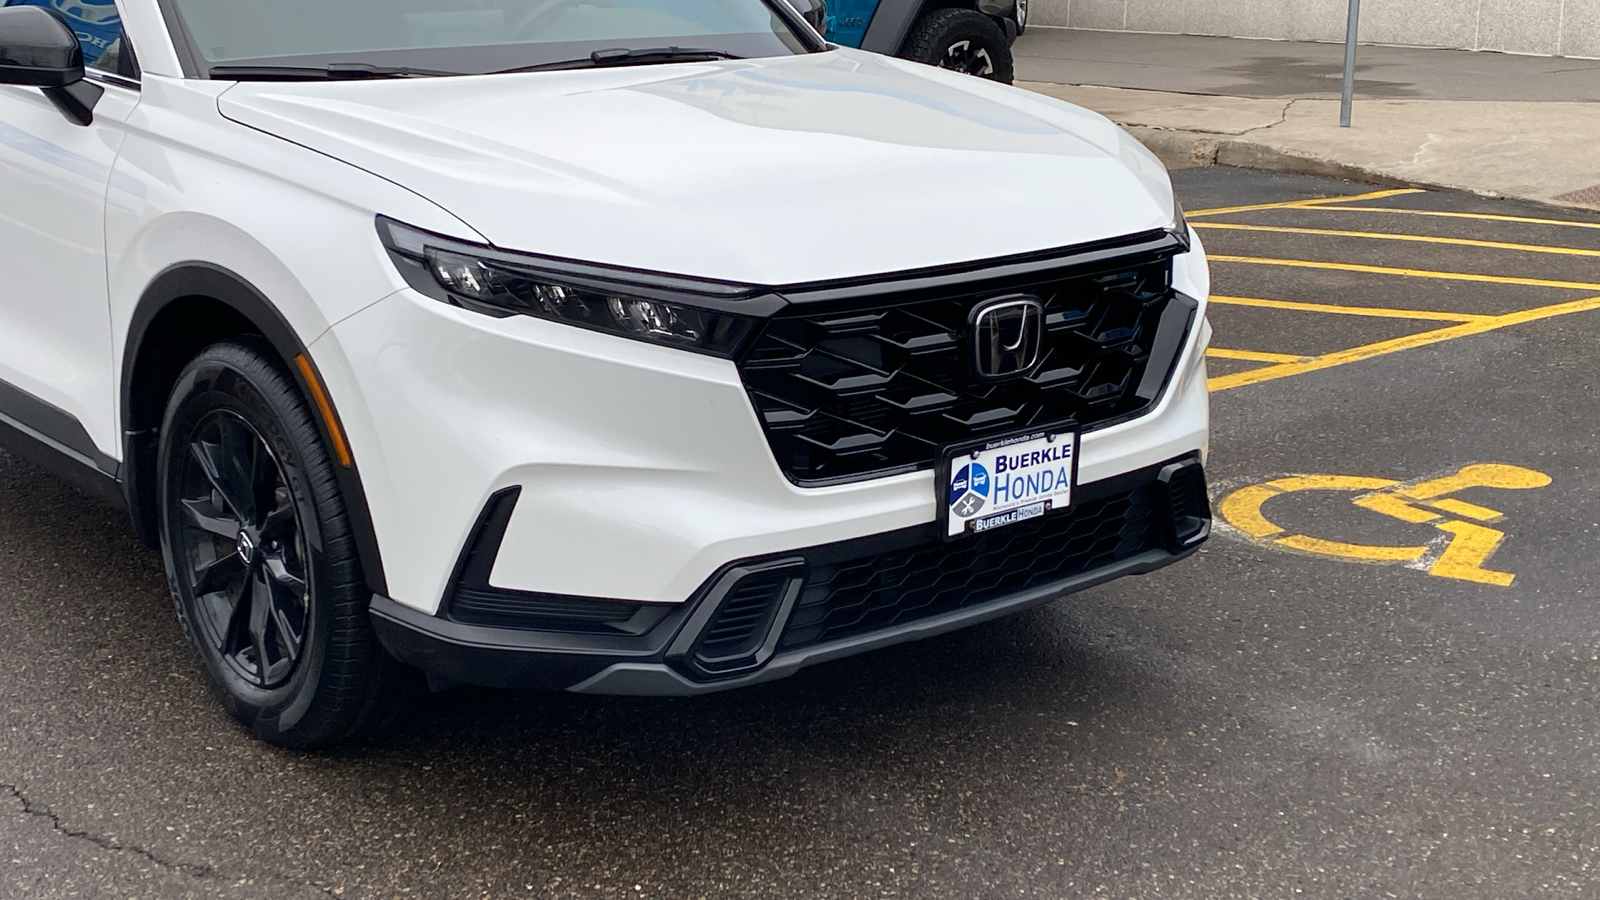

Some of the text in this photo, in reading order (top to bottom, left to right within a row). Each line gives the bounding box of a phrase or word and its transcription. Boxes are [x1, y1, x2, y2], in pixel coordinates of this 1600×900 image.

[995, 444, 1072, 475] BUERKLE
[993, 466, 1069, 505] HONDA
[975, 506, 1043, 531] BUERKLE HONDA
